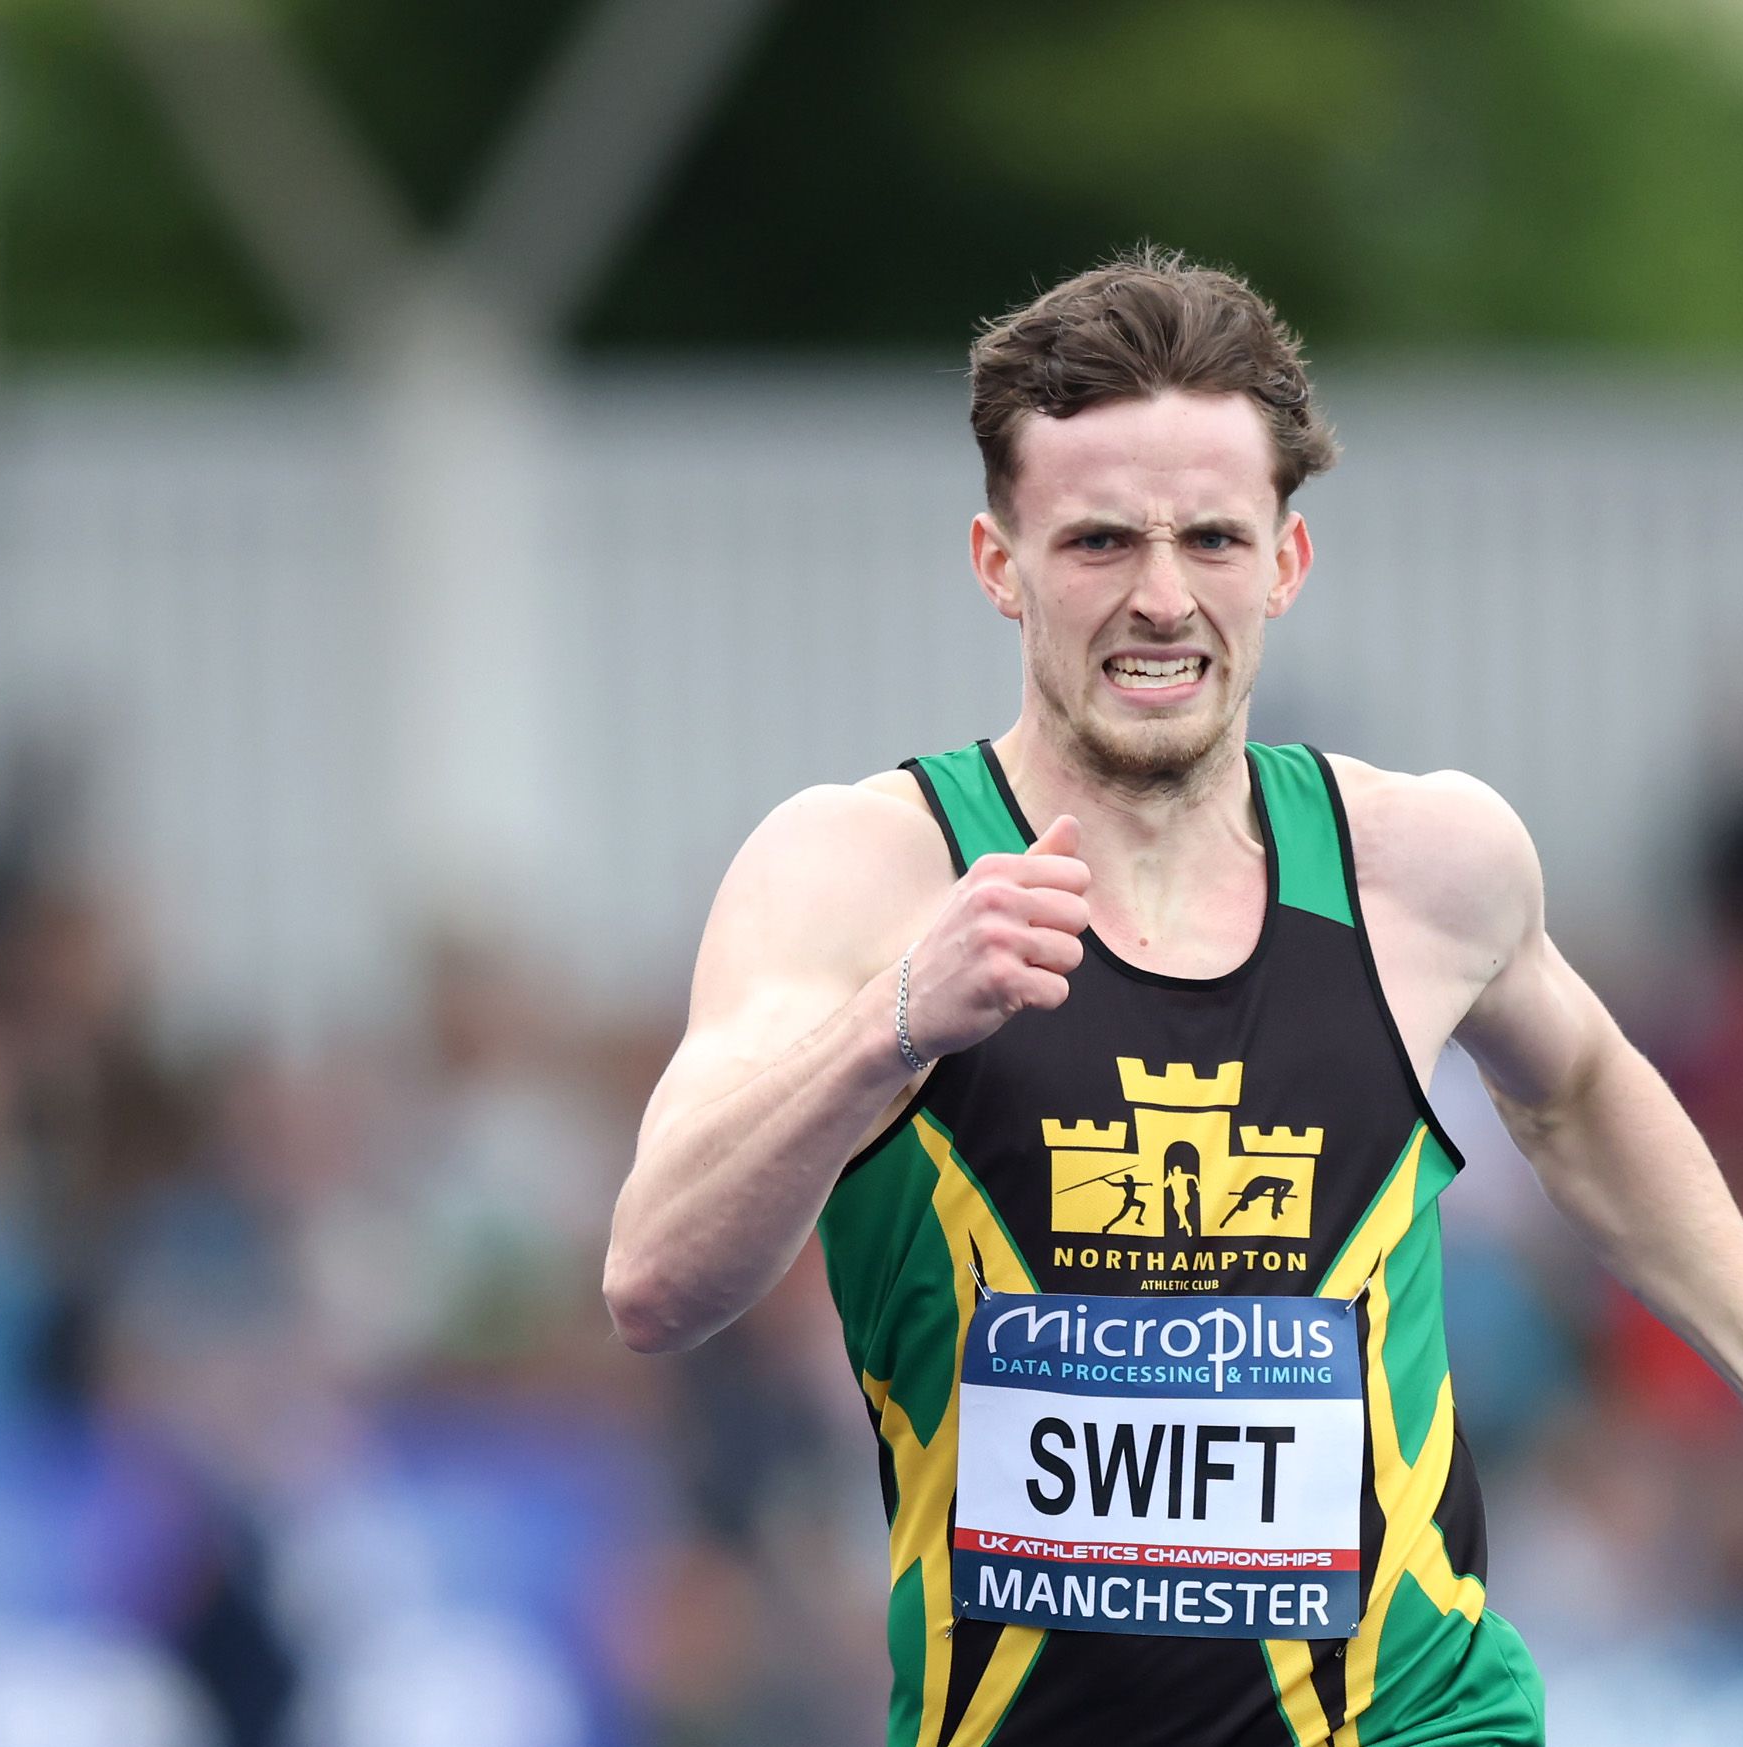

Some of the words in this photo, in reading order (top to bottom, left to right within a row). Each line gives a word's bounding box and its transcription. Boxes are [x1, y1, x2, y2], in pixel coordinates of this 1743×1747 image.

[1053, 1247, 1307, 1272] NORTHAMPTON
[1140, 1279, 1190, 1291] ATHLETIC
[1191, 1279, 1220, 1291] CLUB
[992, 1357, 1052, 1378] DATA
[1061, 1362, 1211, 1384] PROCESSING
[1226, 1367, 1242, 1384] &
[1248, 1366, 1332, 1384] TIMING
[1025, 1416, 1296, 1523] SWIFT
[978, 1533, 1010, 1553] UK
[1012, 1540, 1139, 1562] ATHLETICS
[1144, 1548, 1333, 1568] CHAMPIONSHIPS
[978, 1565, 1331, 1627] MANCHESTER
